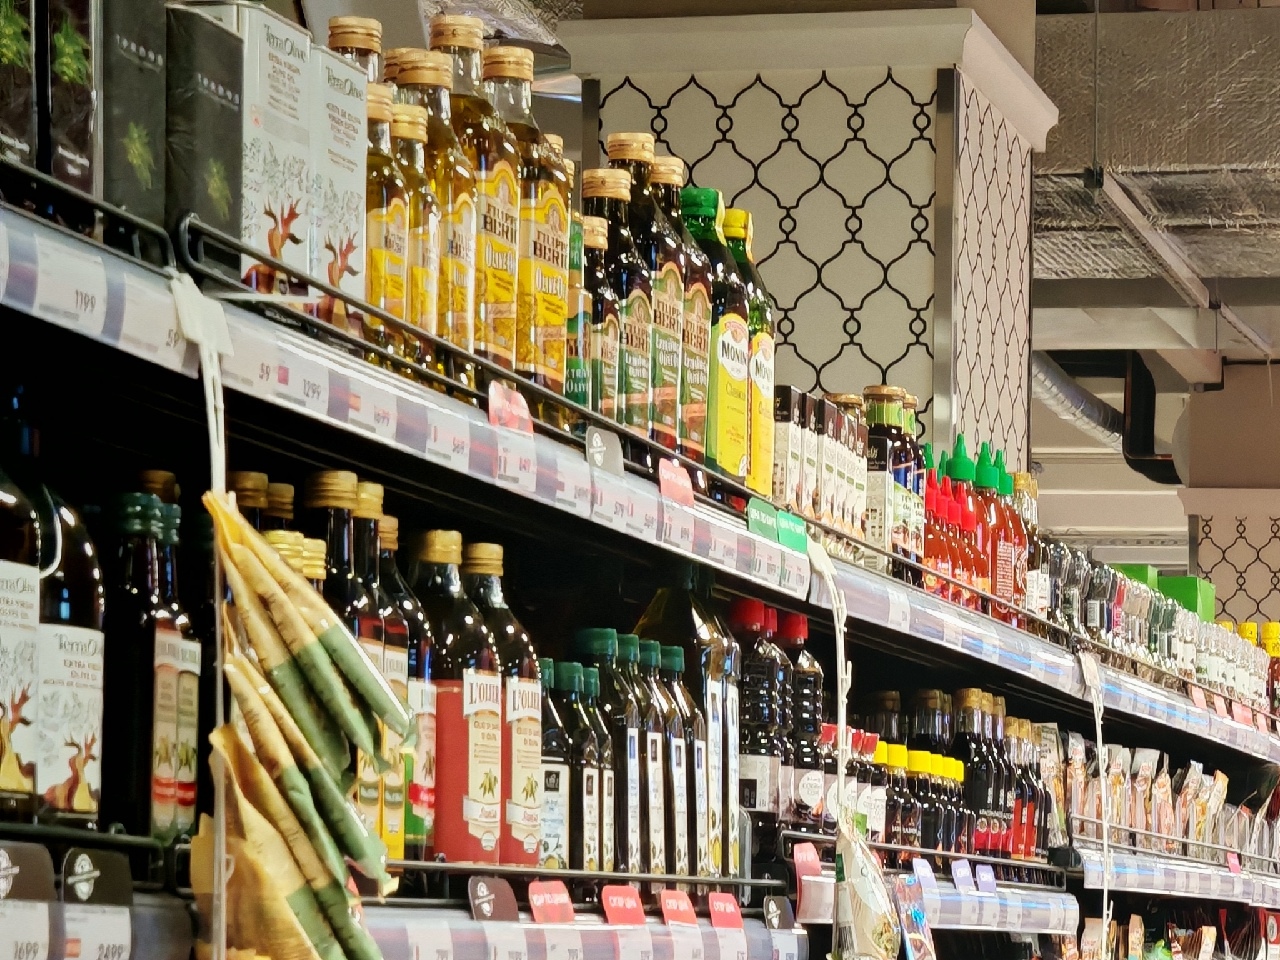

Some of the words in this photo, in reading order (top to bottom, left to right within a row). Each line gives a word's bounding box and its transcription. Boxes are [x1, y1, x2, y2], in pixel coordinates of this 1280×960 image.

[482, 214, 517, 244] BERI
[532, 240, 568, 270] BERI
[653, 308, 682, 336] BERI
[721, 339, 748, 367] MONIN
[53, 632, 99, 657] TerraO
